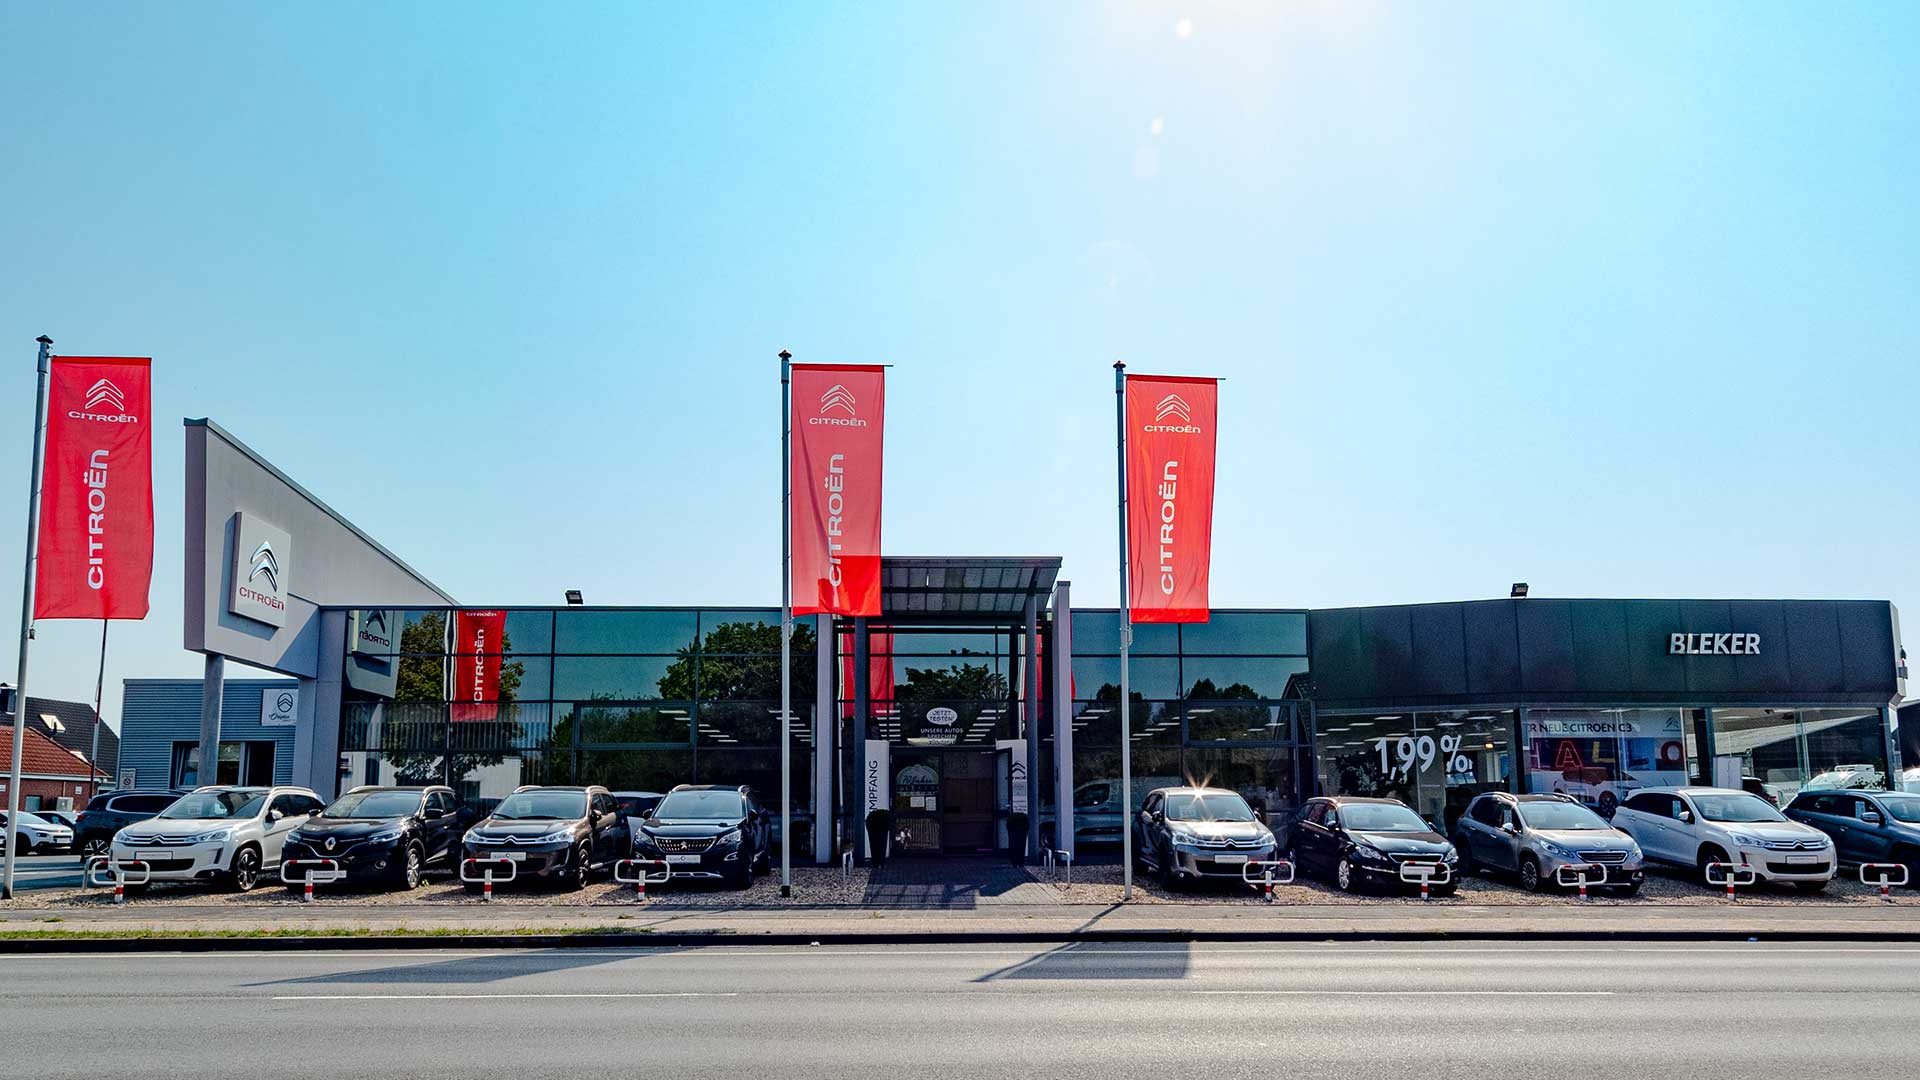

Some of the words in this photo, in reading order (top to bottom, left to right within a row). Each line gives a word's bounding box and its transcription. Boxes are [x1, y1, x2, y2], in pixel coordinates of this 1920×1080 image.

[68, 410, 138, 424] CITROËN
[809, 417, 867, 427] CITROËN
[1144, 424, 1201, 434] CITROËN
[84, 449, 110, 590] CITROËN
[824, 453, 844, 588] CITROËN
[1158, 460, 1179, 596] CITROËN
[239, 586, 285, 611] CITROËN
[1670, 633, 1761, 655] BLEKER
[1539, 723, 1569, 733] NEUE
[1618, 723, 1632, 733] C3
[868, 760, 879, 811] MPFANG
